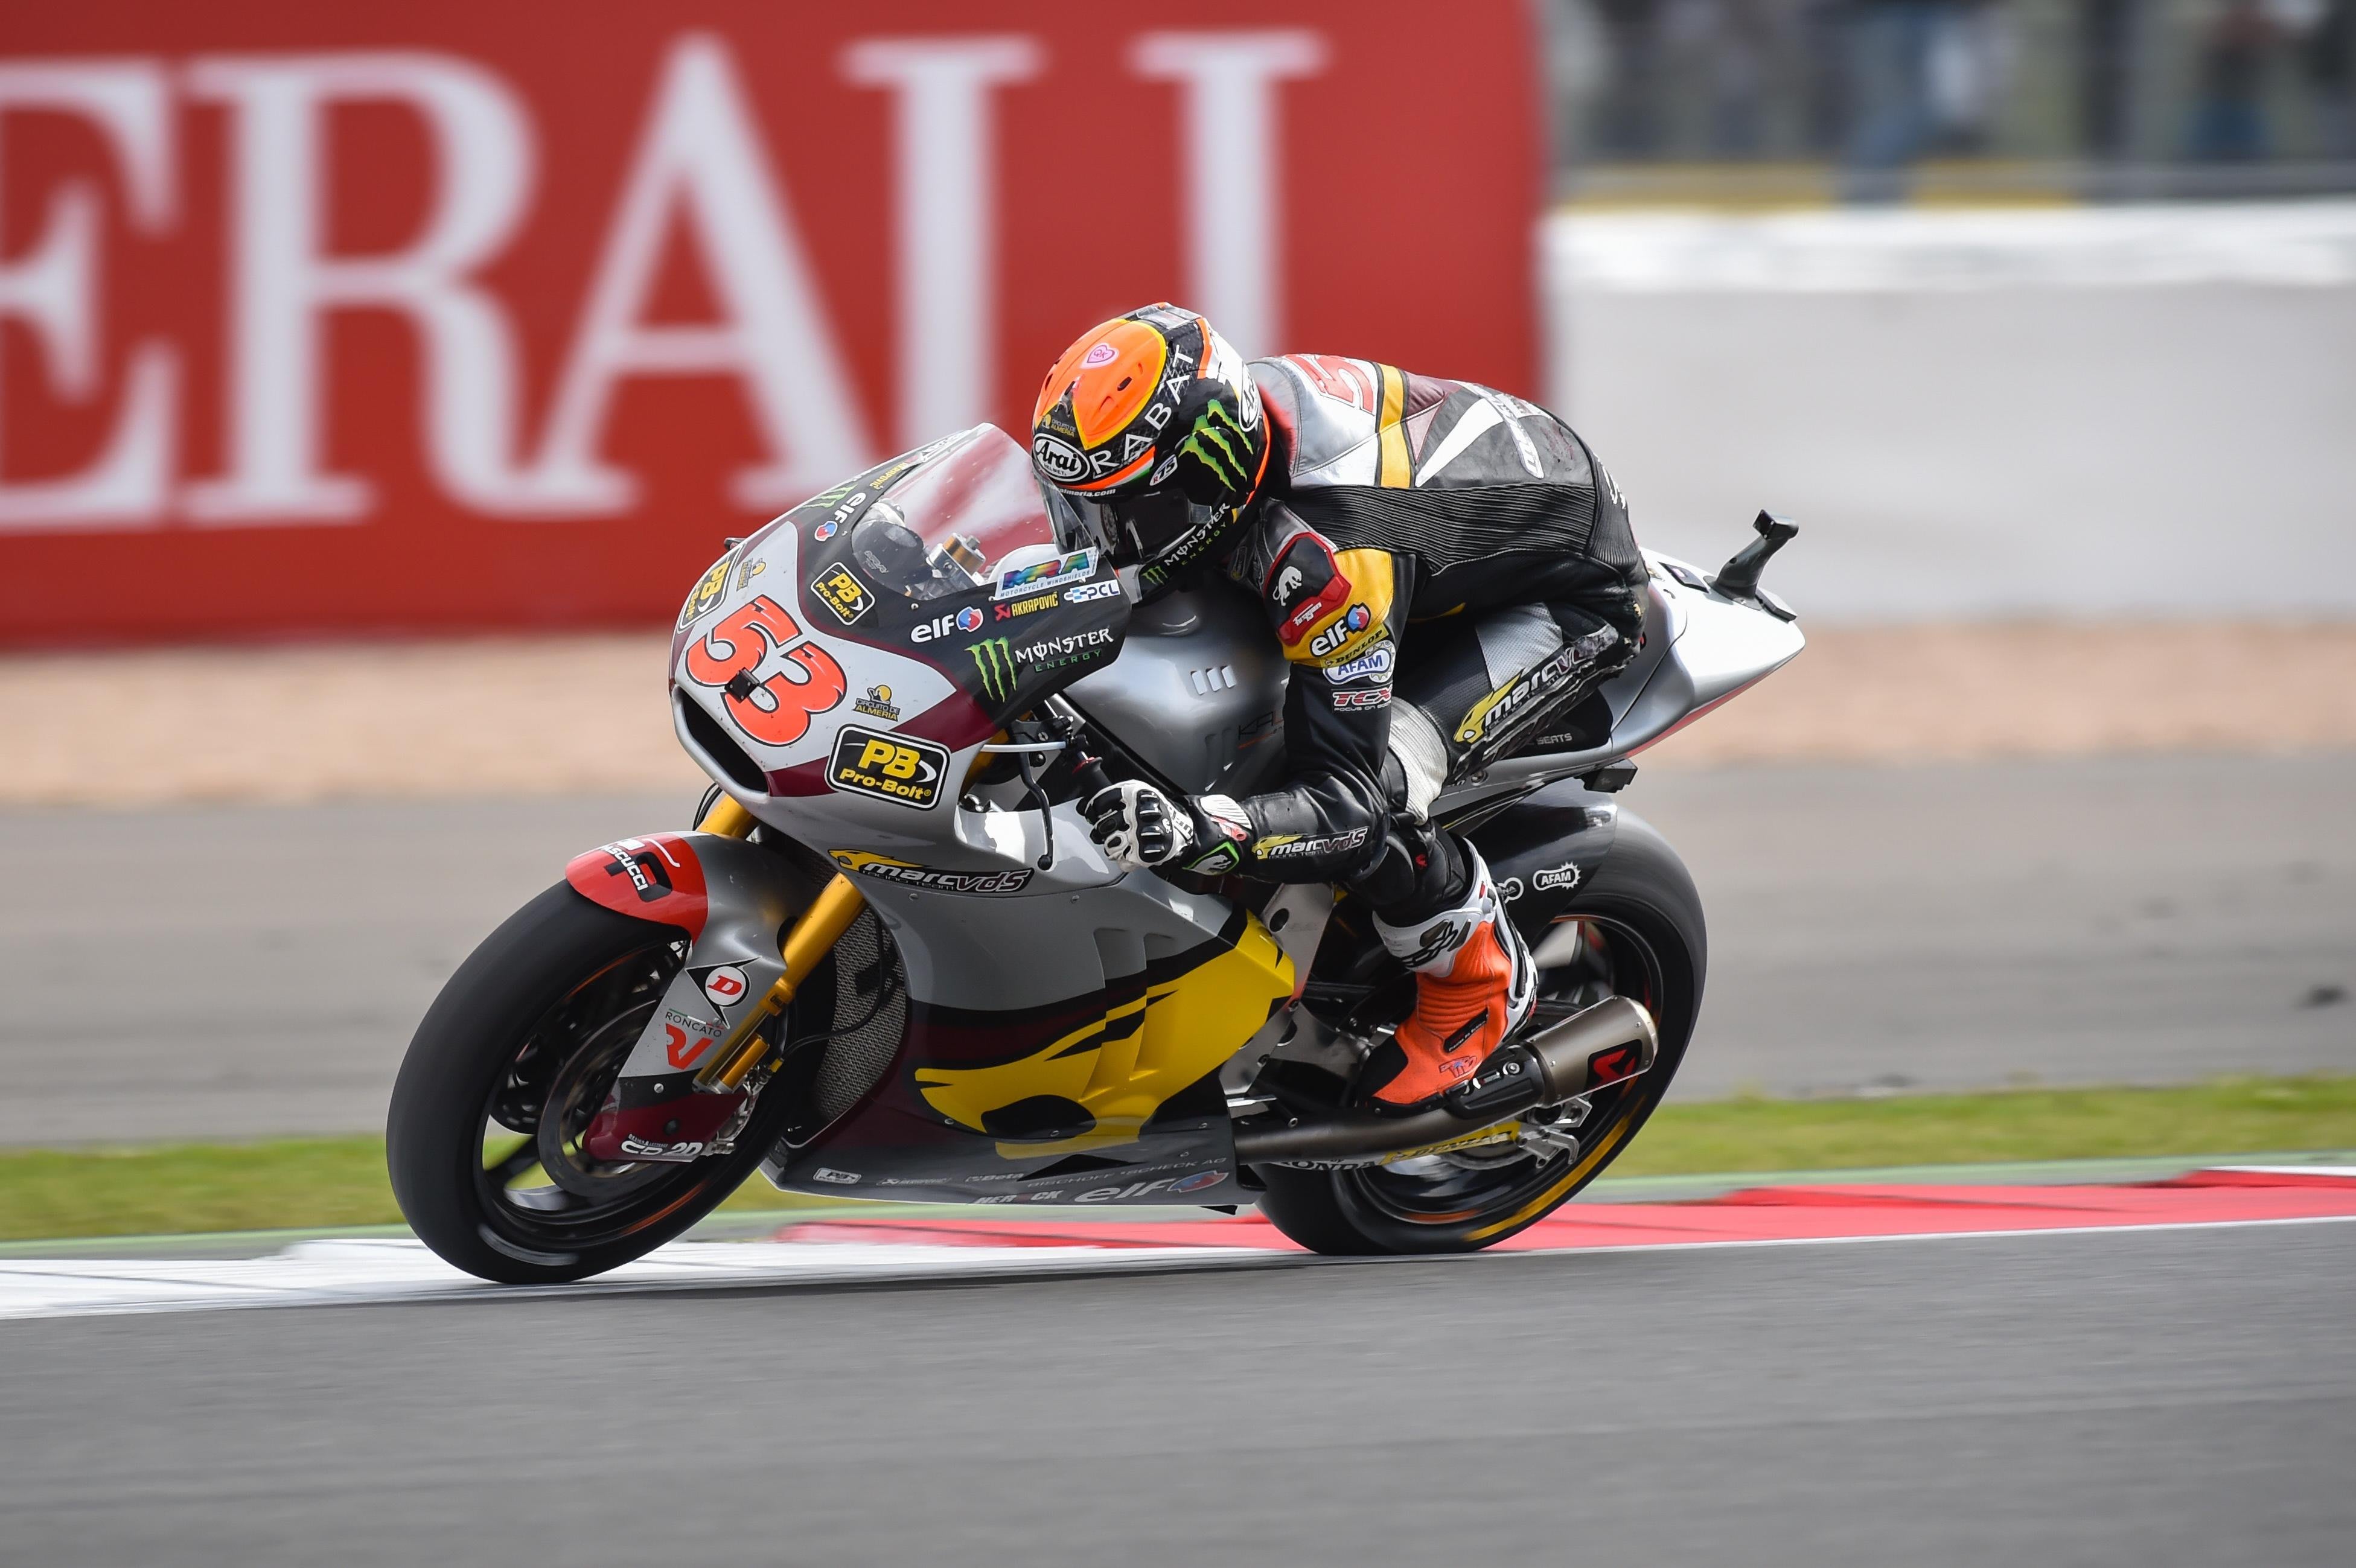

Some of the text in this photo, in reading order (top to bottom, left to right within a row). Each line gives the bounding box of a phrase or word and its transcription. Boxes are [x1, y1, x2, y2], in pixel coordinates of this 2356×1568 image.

[1089, 344, 1194, 474] RABAT
[1036, 441, 1079, 472] Arai
[834, 492, 866, 523] elf
[700, 560, 730, 601] PB
[1000, 570, 1090, 598] MOTORCYCLE WINDSHIELDS
[1002, 552, 1090, 590] MRA
[828, 573, 862, 604] PB
[1085, 581, 1120, 600] PCL
[910, 614, 954, 643] elf
[1311, 619, 1347, 656] elf
[1015, 626, 1114, 663] MONSTER
[1335, 629, 1383, 664] DUNLOP
[686, 594, 848, 747] 53
[1035, 649, 1102, 673] ENERGY
[1338, 655, 1384, 676] AFAM
[856, 698, 889, 711] CIRCUITO
[1332, 683, 1393, 706] TCX
[855, 705, 898, 721] ALMERIA
[858, 739, 921, 779] PB
[1541, 871, 1571, 886] AFAM
[707, 975, 742, 996] D
[665, 1012, 722, 1037] RONCATO
[1074, 1178, 1176, 1203] elf
